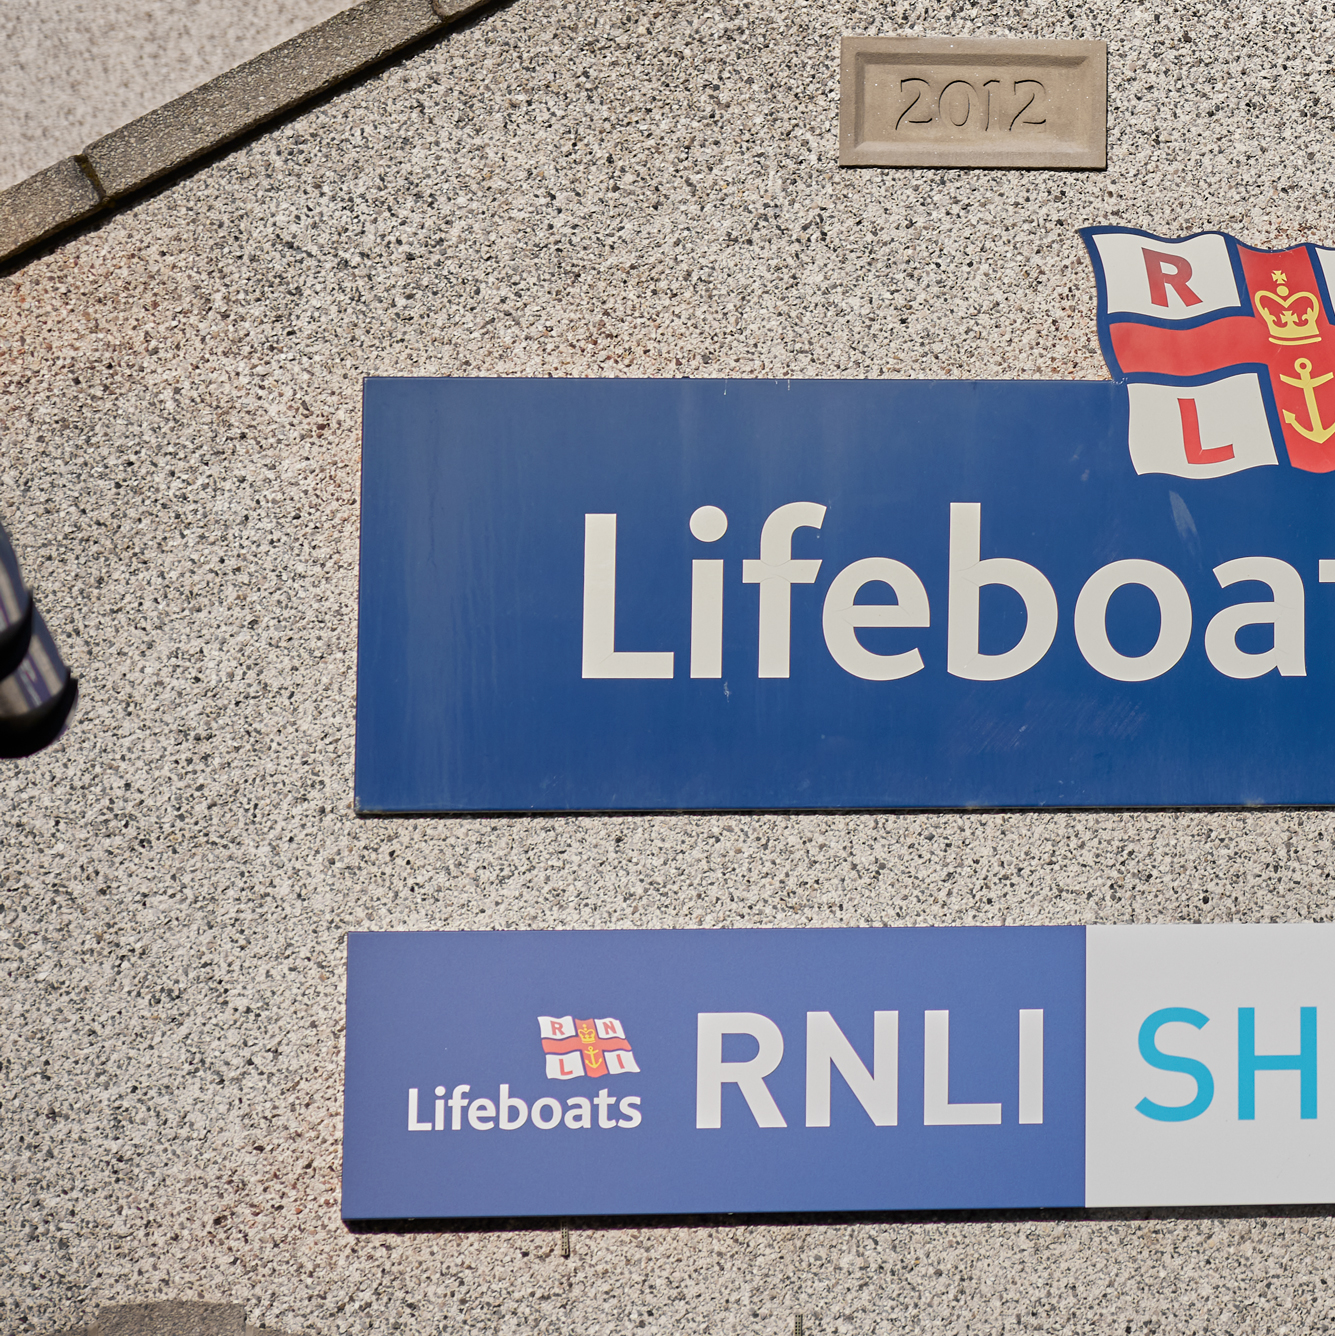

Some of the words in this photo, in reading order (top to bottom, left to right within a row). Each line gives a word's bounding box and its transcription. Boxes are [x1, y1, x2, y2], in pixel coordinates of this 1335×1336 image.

[894, 76, 1048, 132] 2012
[1141, 247, 1203, 307] R
[1177, 397, 1235, 465] L
[550, 1020, 565, 1036] R
[602, 1020, 617, 1035] N
[558, 1058, 573, 1076] L
[696, 1008, 1045, 1129] RNLI
[407, 1083, 643, 1132] Lifeboats
